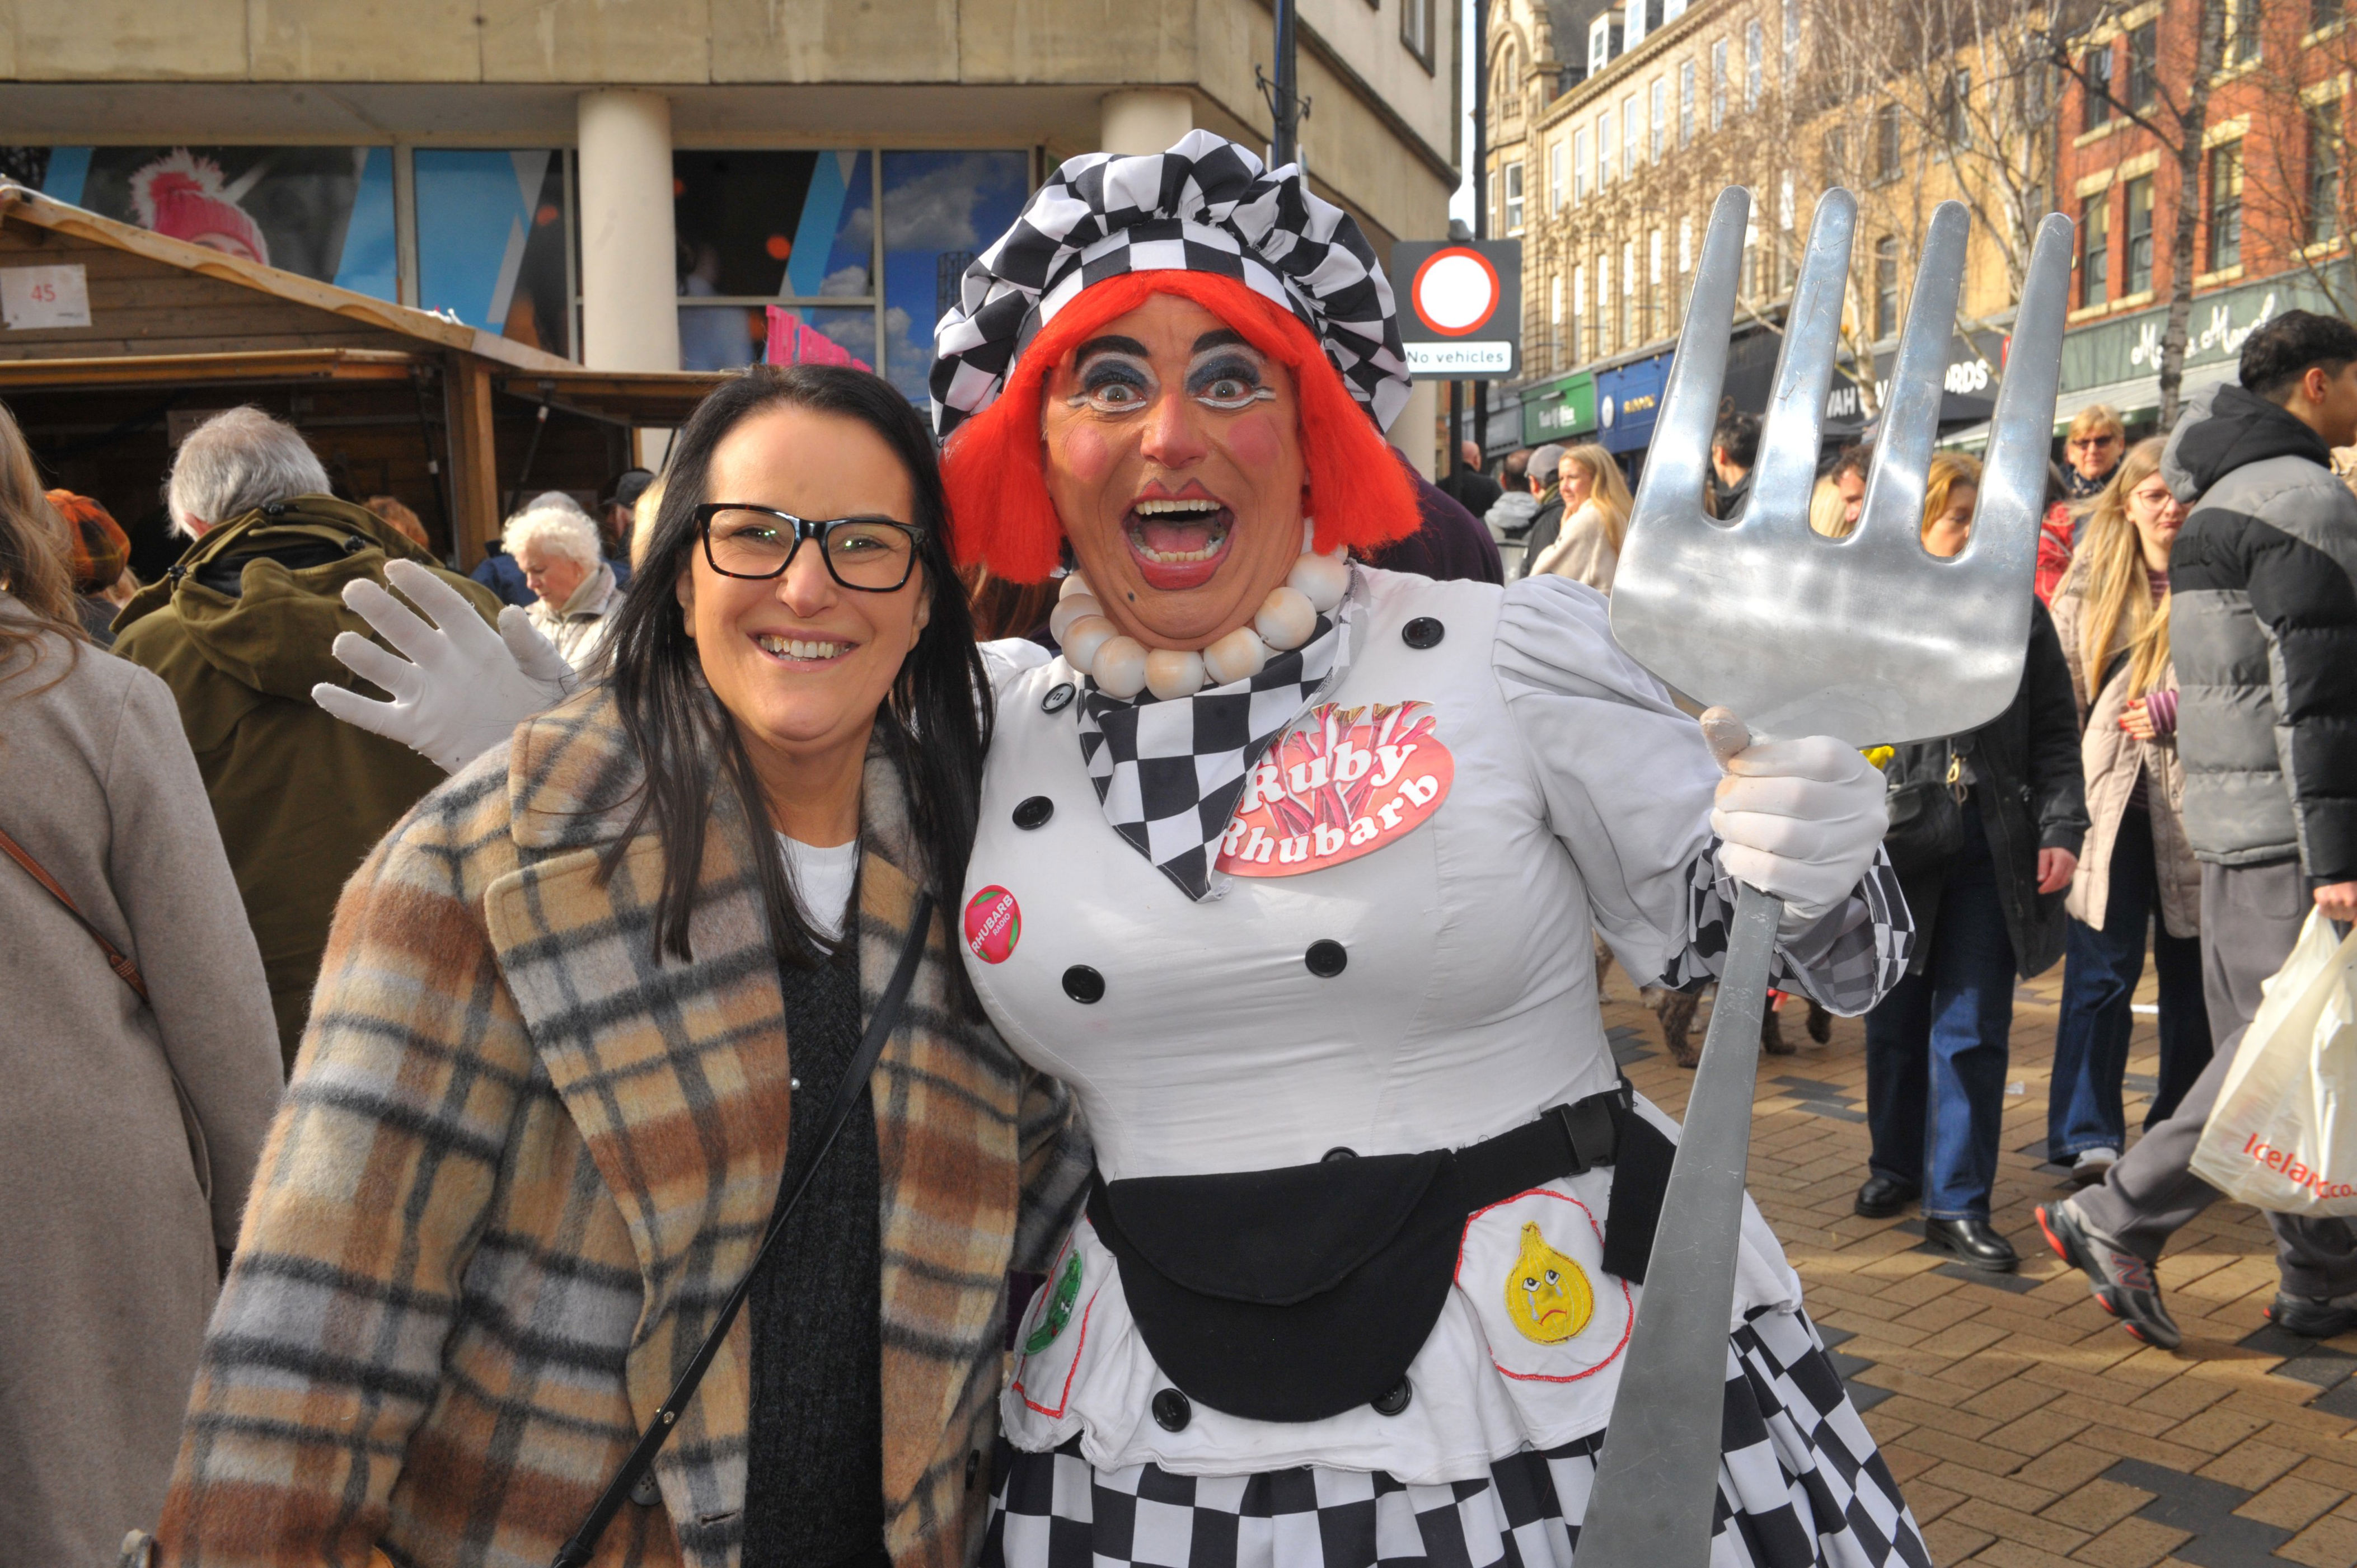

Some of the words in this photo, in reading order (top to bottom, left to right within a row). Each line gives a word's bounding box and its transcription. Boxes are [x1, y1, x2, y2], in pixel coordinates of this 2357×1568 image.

[31, 284, 56, 302] 45
[1407, 351, 1428, 363] No
[1436, 350, 1503, 363] vehicles
[1944, 358, 1988, 394] RDS
[1240, 741, 1418, 813] Ruby
[1223, 774, 1440, 863] Rhubarb
[971, 894, 1014, 953] RHUBARB
[992, 913, 1010, 936] RADIO
